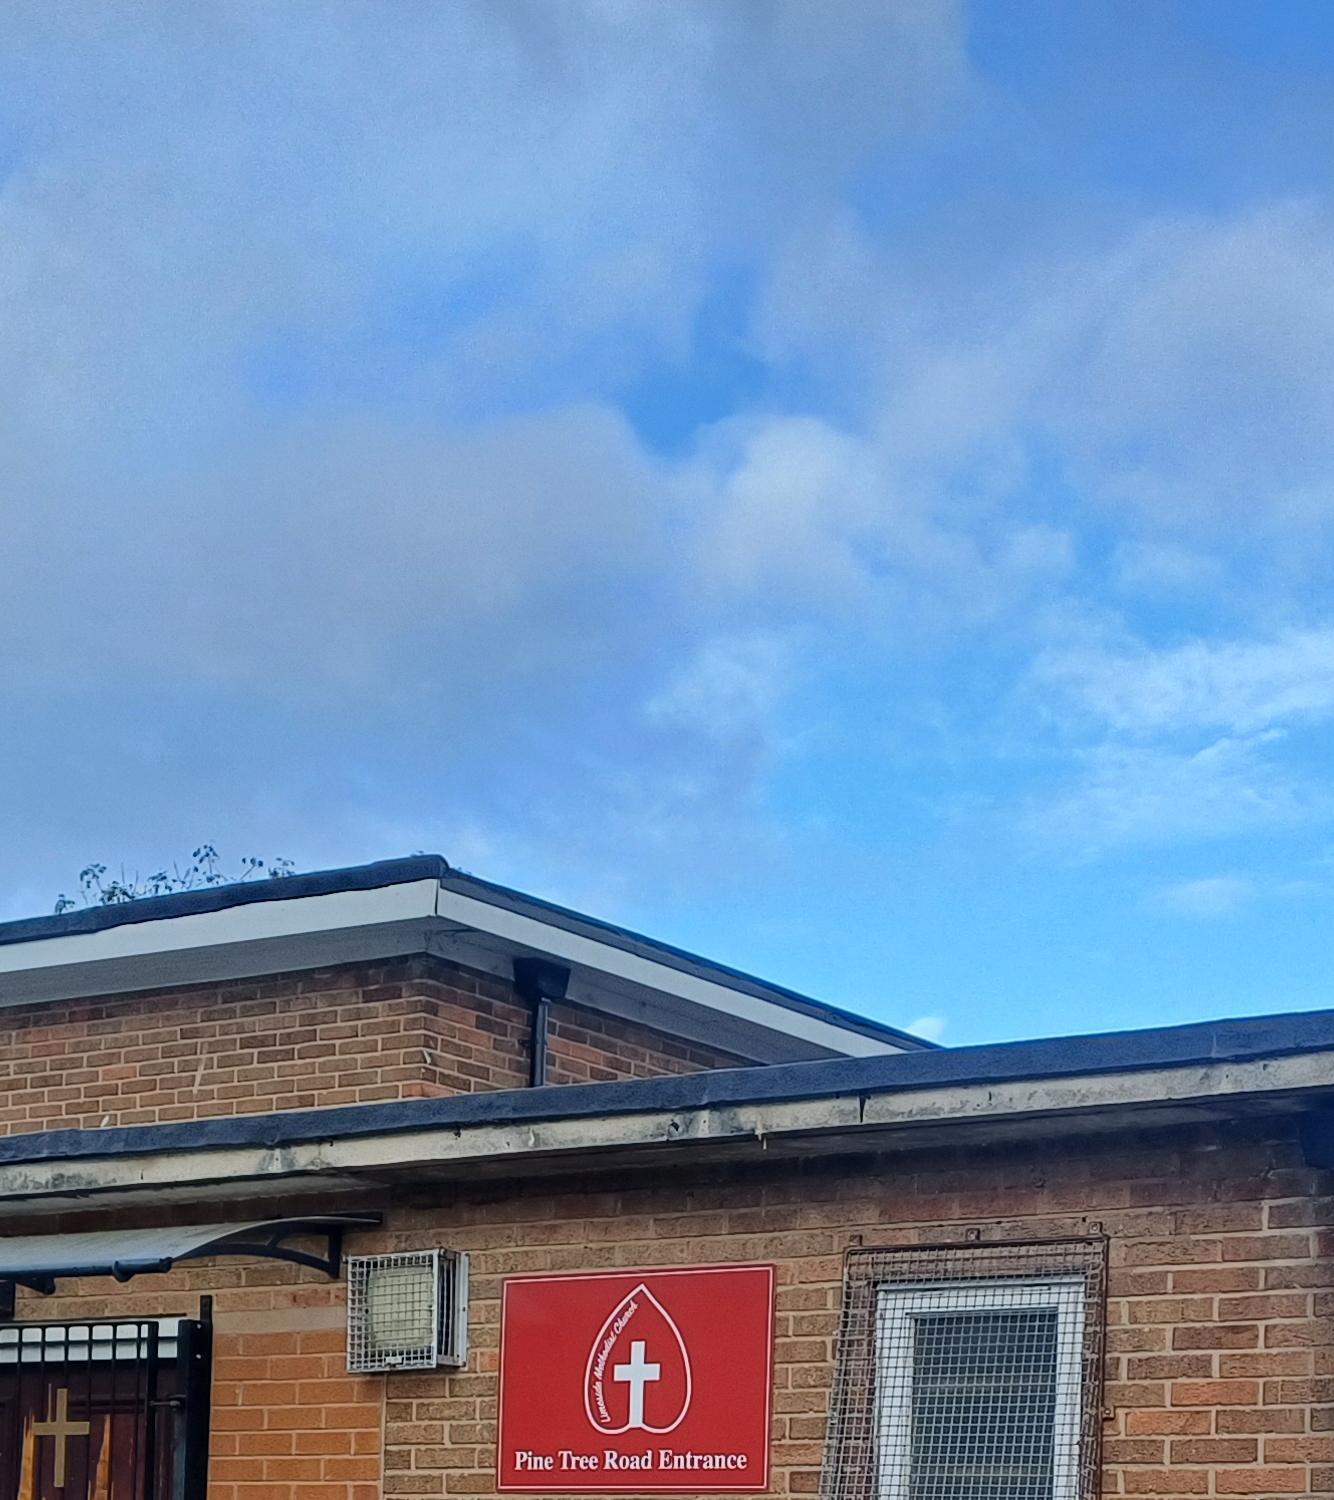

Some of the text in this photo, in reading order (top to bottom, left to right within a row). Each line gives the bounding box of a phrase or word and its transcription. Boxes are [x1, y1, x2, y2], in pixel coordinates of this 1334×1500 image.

[593, 1330, 617, 1380] Methodist
[613, 1299, 638, 1335] Church
[514, 1449, 748, 1471] Pine Tree Road Entrance
